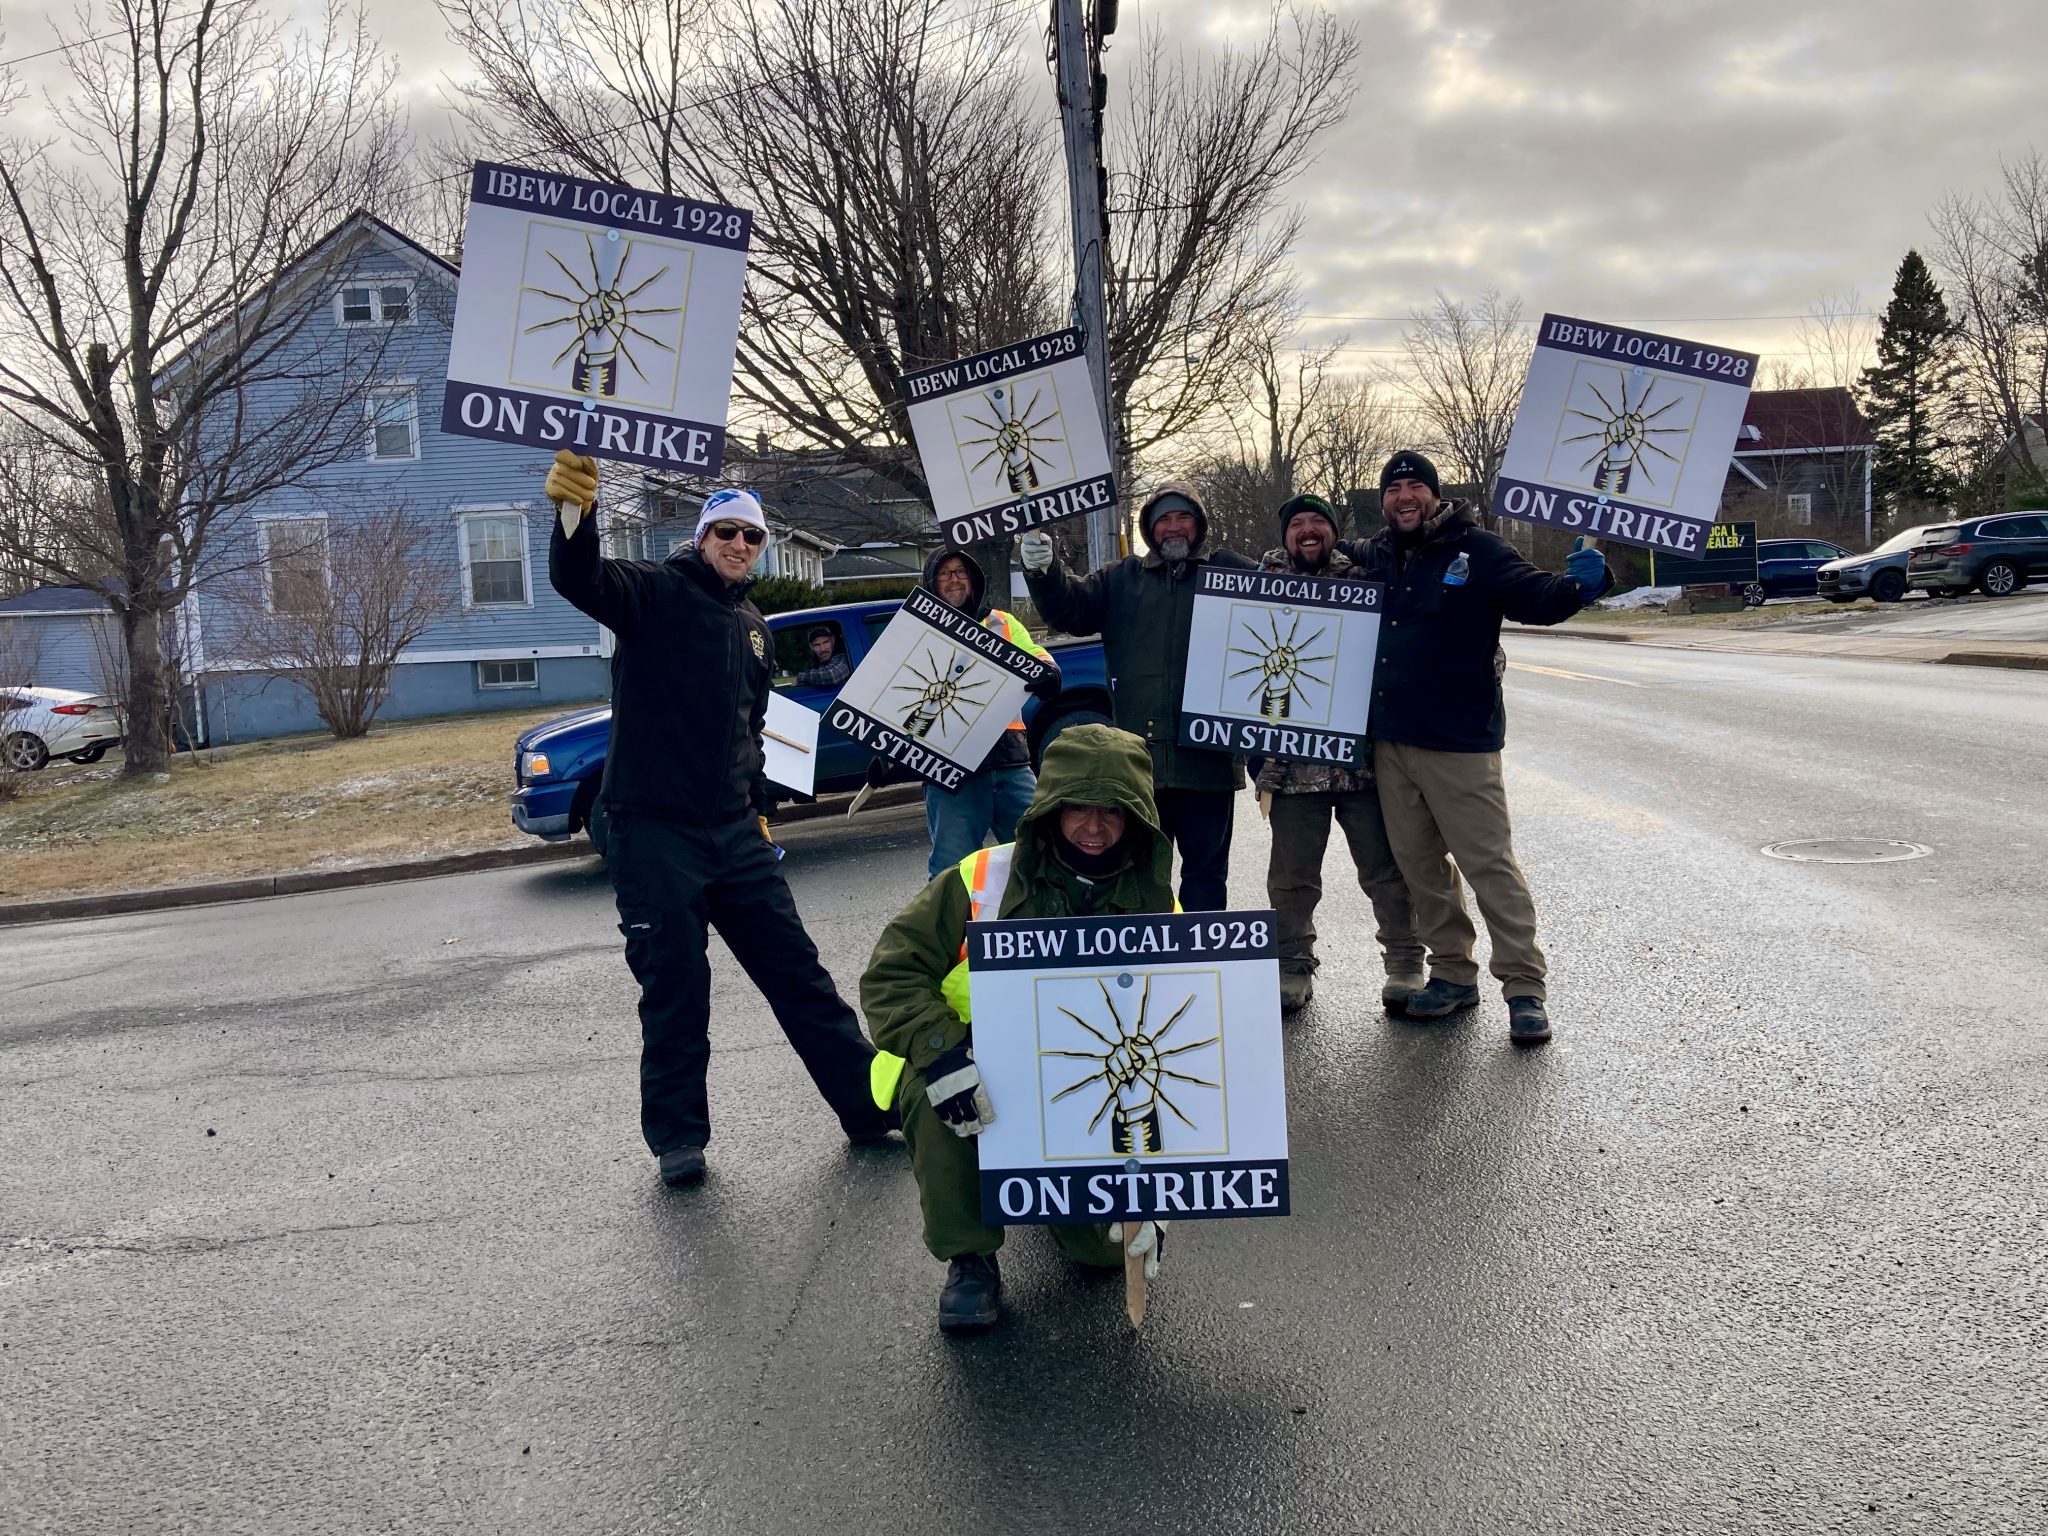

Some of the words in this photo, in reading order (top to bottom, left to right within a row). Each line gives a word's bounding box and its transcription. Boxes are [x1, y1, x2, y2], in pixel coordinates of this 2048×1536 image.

[486, 169, 566, 206] IBEW
[572, 185, 663, 225] LOCAL
[672, 205, 742, 239] 1928
[909, 367, 960, 397] IBEW
[964, 350, 1026, 380] LOCAL
[1029, 334, 1076, 362] 1928
[1548, 322, 1611, 349] IBEW
[1612, 334, 1684, 366] LOCAL
[1690, 351, 1749, 378] 1928
[460, 392, 529, 435] ON
[540, 405, 712, 466] STRIKE
[952, 513, 995, 545] ON
[1002, 480, 1110, 532] STRIKE
[1504, 486, 1558, 520] ON
[1563, 499, 1701, 552] STRIKE
[1204, 572, 1256, 593] IBEW
[1260, 578, 1322, 600] LOCAL
[1328, 585, 1377, 606] 1928
[911, 594, 959, 628] IBEW
[955, 620, 1002, 658] LOCAL
[1004, 650, 1044, 679] 1928
[832, 709, 873, 741] ON
[872, 731, 965, 790] STRIKE
[1189, 719, 1233, 746] ON
[1240, 726, 1356, 763] STRIKE
[982, 929, 1067, 959] IBEW
[1076, 924, 1179, 956] LOCAL
[1189, 920, 1268, 951] 1928
[999, 1176, 1071, 1216] ON
[1088, 1168, 1278, 1214] STRIKE
